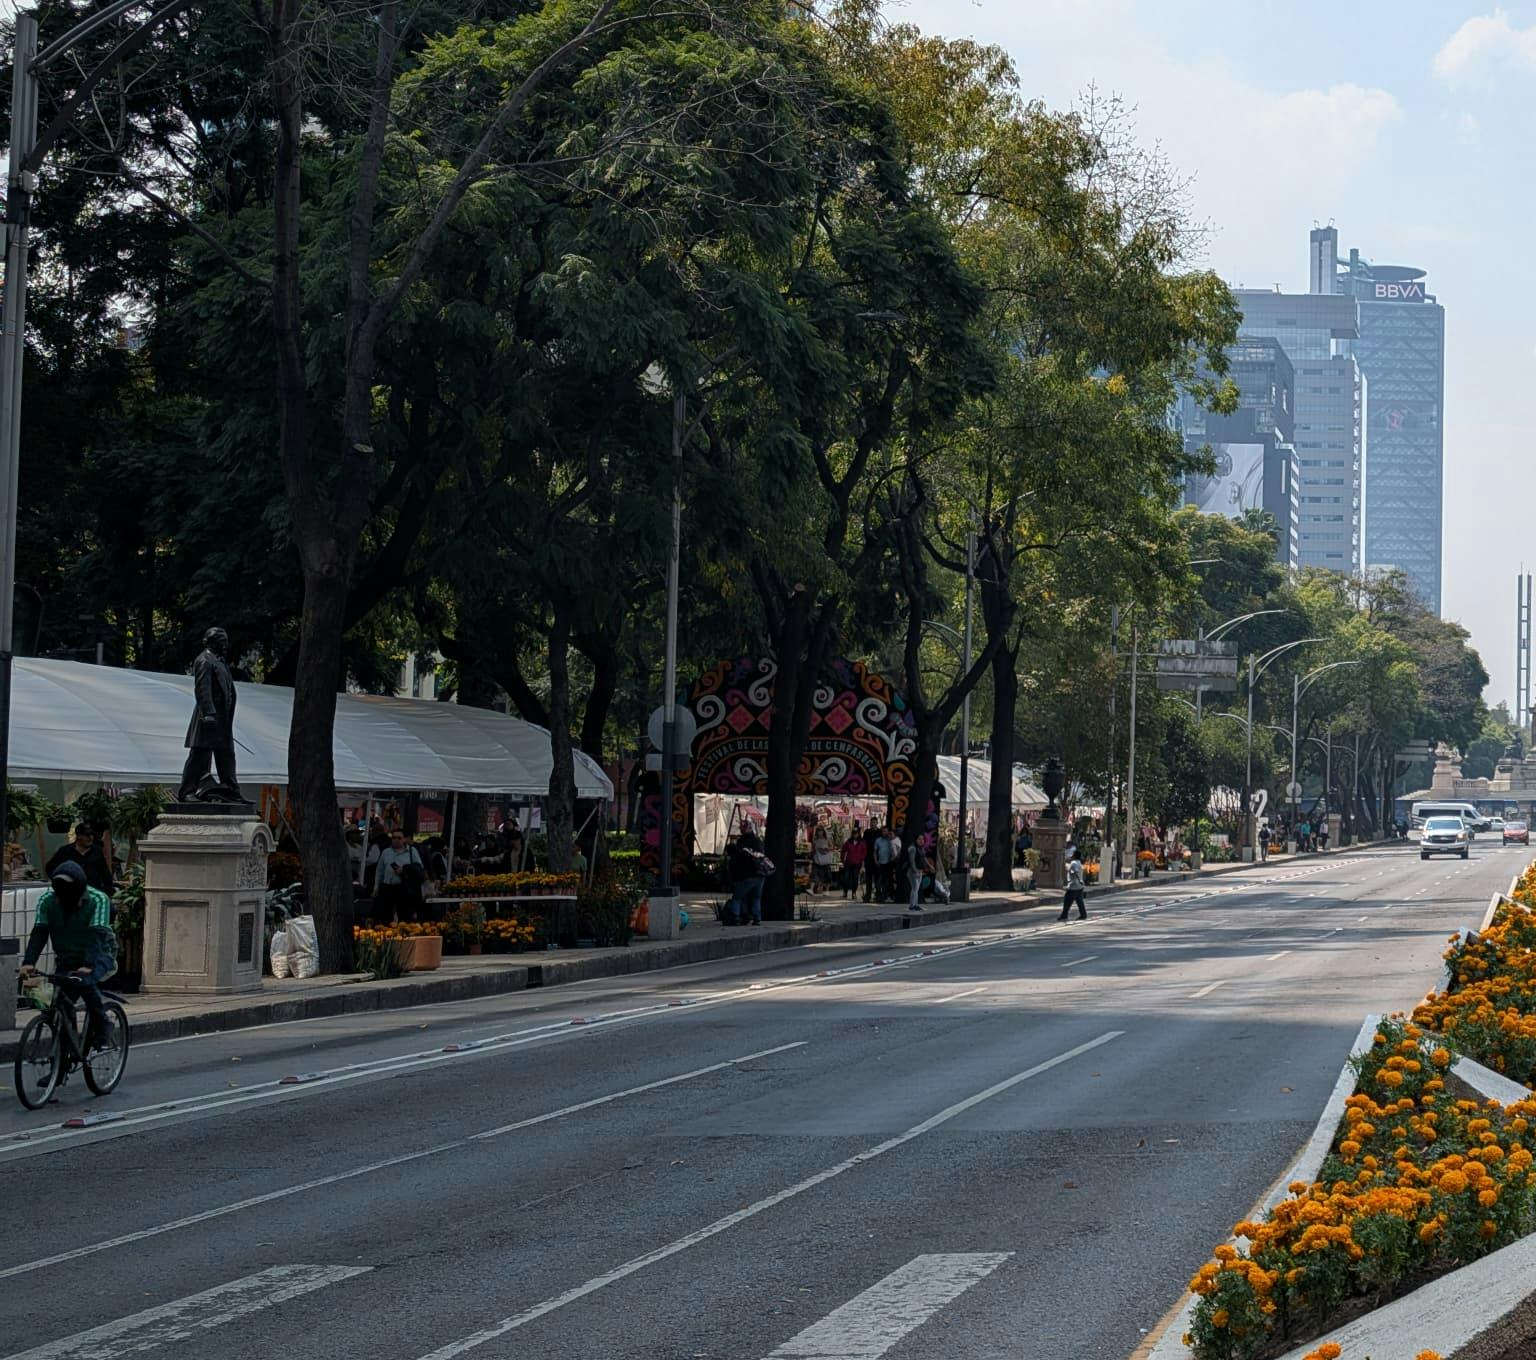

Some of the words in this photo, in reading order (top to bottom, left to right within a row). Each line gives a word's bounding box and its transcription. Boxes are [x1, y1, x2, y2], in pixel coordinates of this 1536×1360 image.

[1375, 283, 1423, 299] BBVA
[697, 742, 733, 780] FESTIVAL
[737, 740, 749, 751] DE
[811, 741, 823, 752] DE
